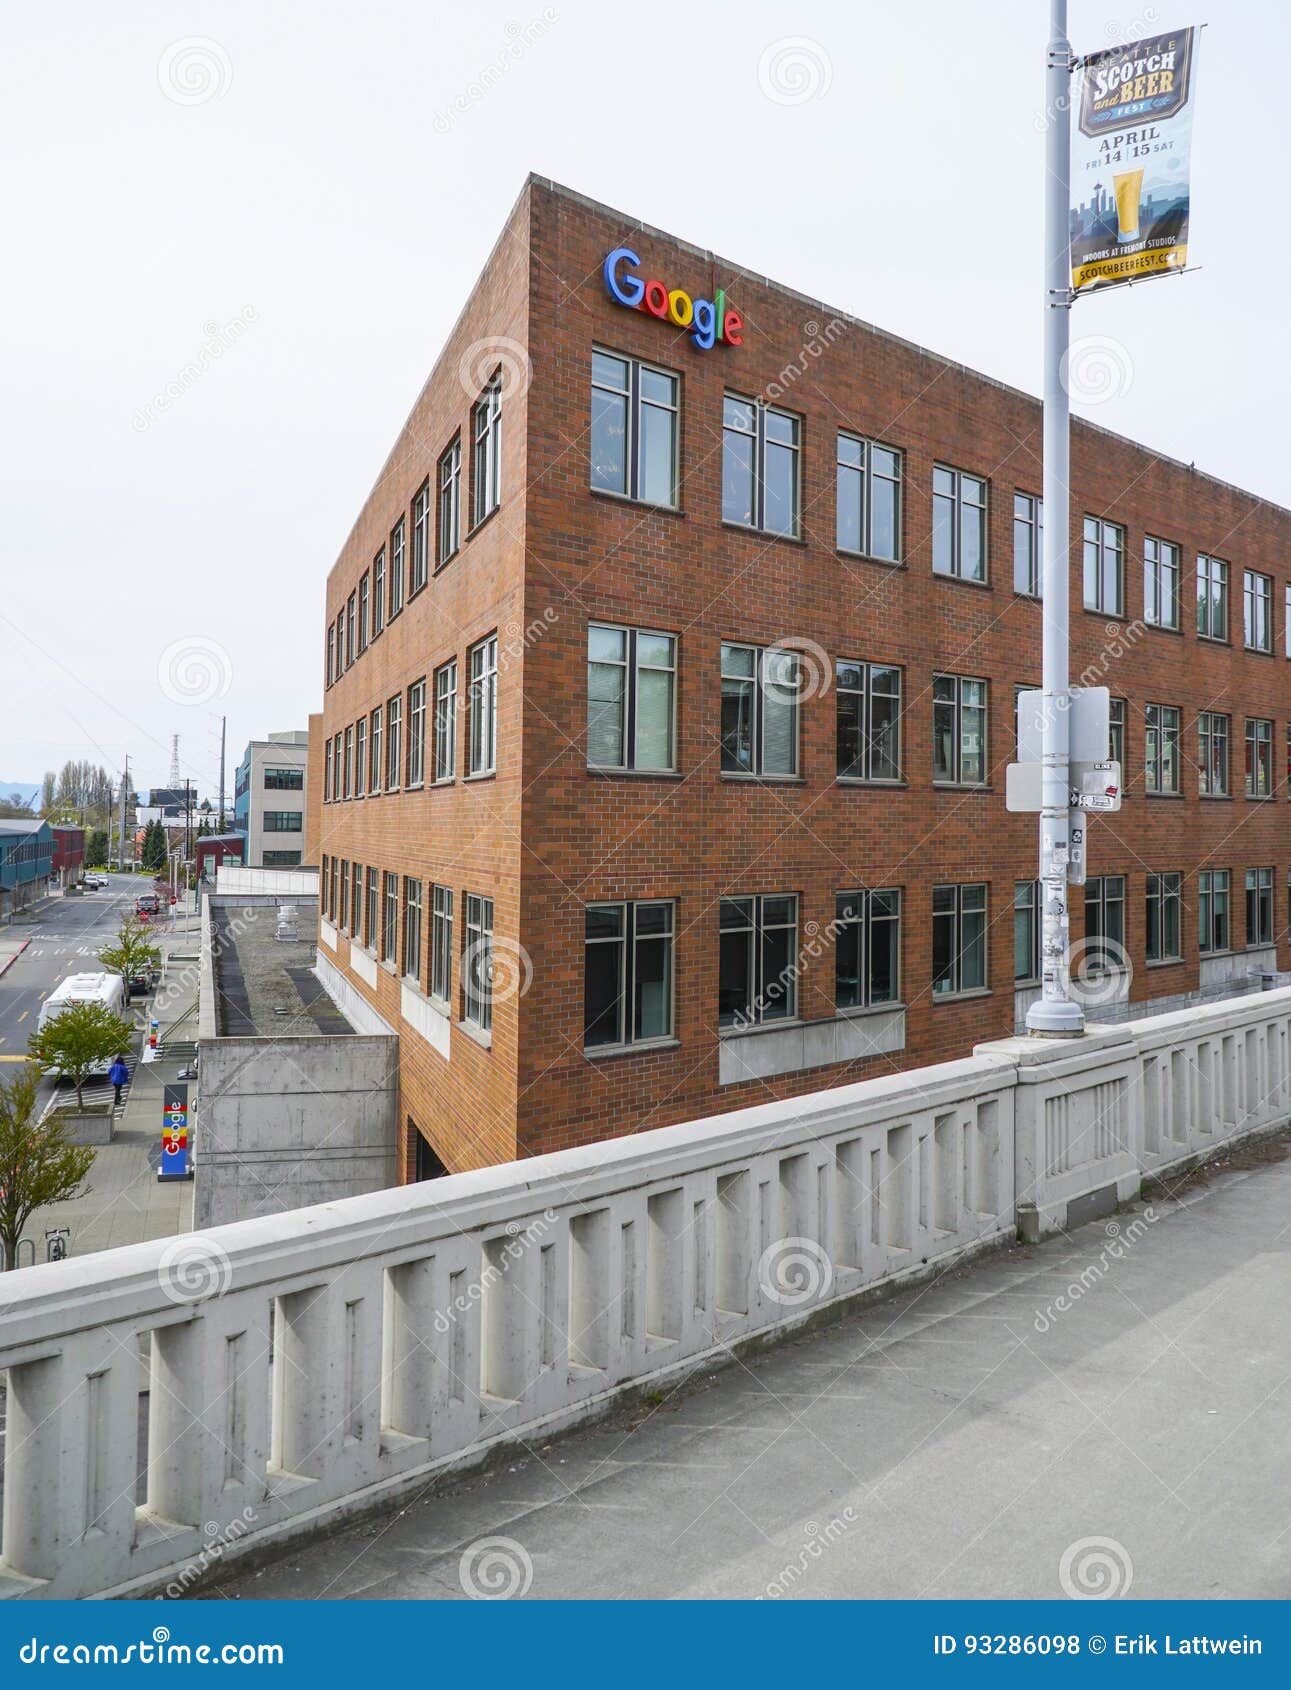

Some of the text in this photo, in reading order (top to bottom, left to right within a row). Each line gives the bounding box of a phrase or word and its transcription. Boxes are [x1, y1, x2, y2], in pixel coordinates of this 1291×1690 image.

[1098, 40, 1176, 69] SEATTLE
[1093, 70, 1174, 110] and BEER
[1094, 51, 1176, 101] SCOTCH
[1117, 103, 1145, 116] FEST
[1099, 127, 1160, 152] APRIL
[1085, 140, 1176, 170] FRI 14 15 SAT
[1110, 247, 1119, 257] AT
[1147, 235, 1176, 249] STUDIOS
[603, 246, 744, 350] Google
[165, 1101, 185, 1156] Google
